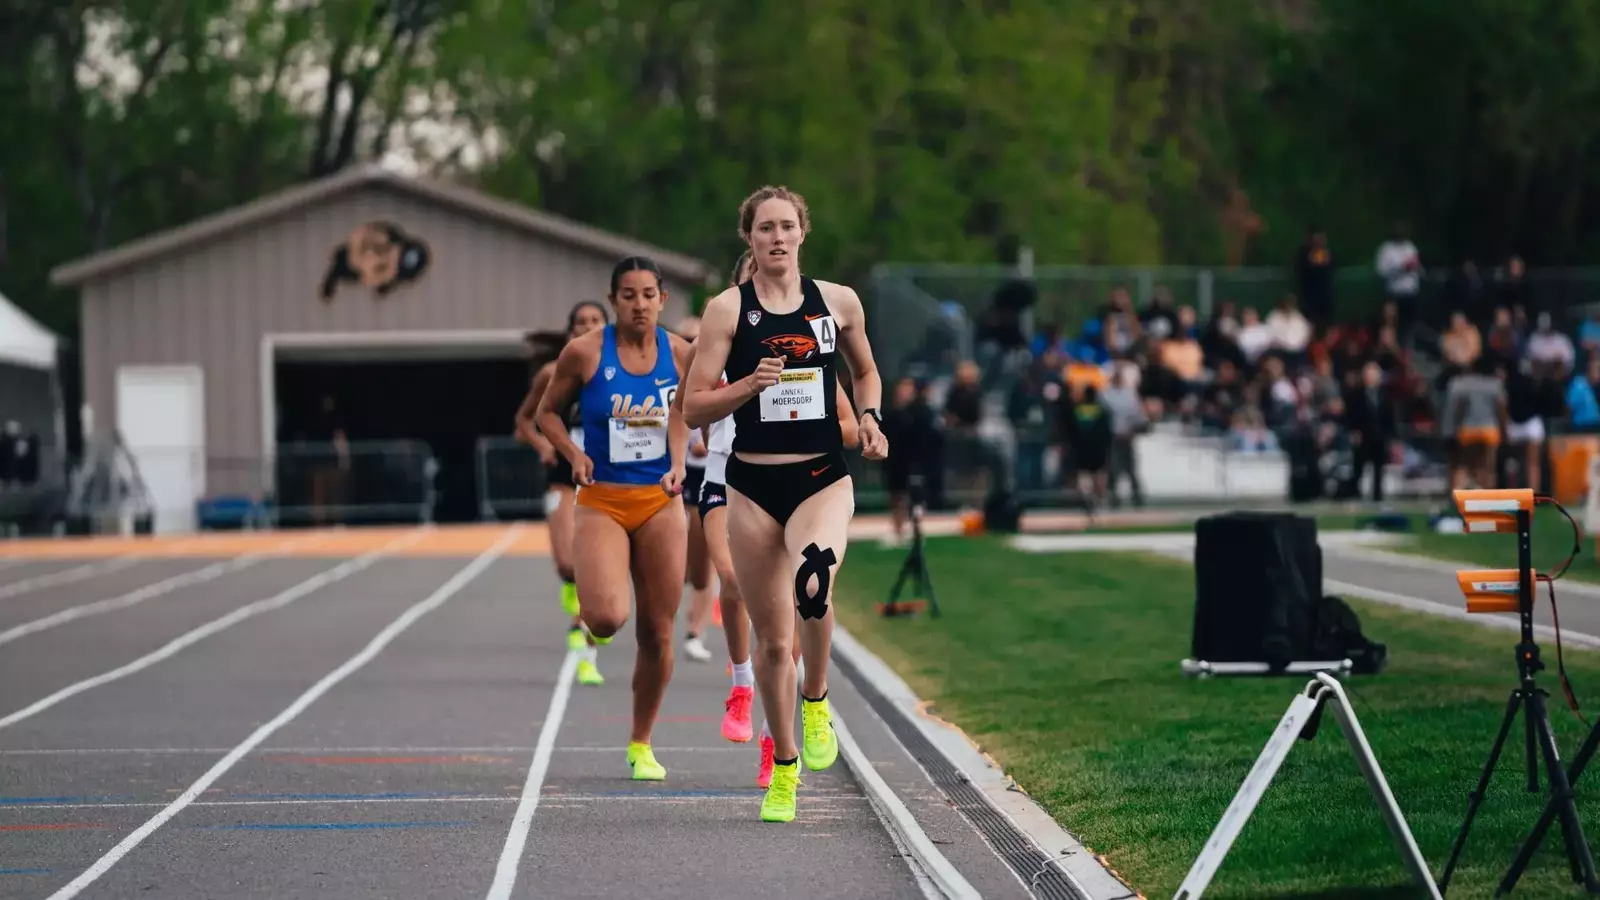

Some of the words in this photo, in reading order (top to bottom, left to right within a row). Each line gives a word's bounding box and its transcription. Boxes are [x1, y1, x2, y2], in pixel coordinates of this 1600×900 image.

[821, 319, 834, 350] 4
[780, 388, 804, 396] ANNEKE
[772, 396, 813, 406] MOERSDORF
